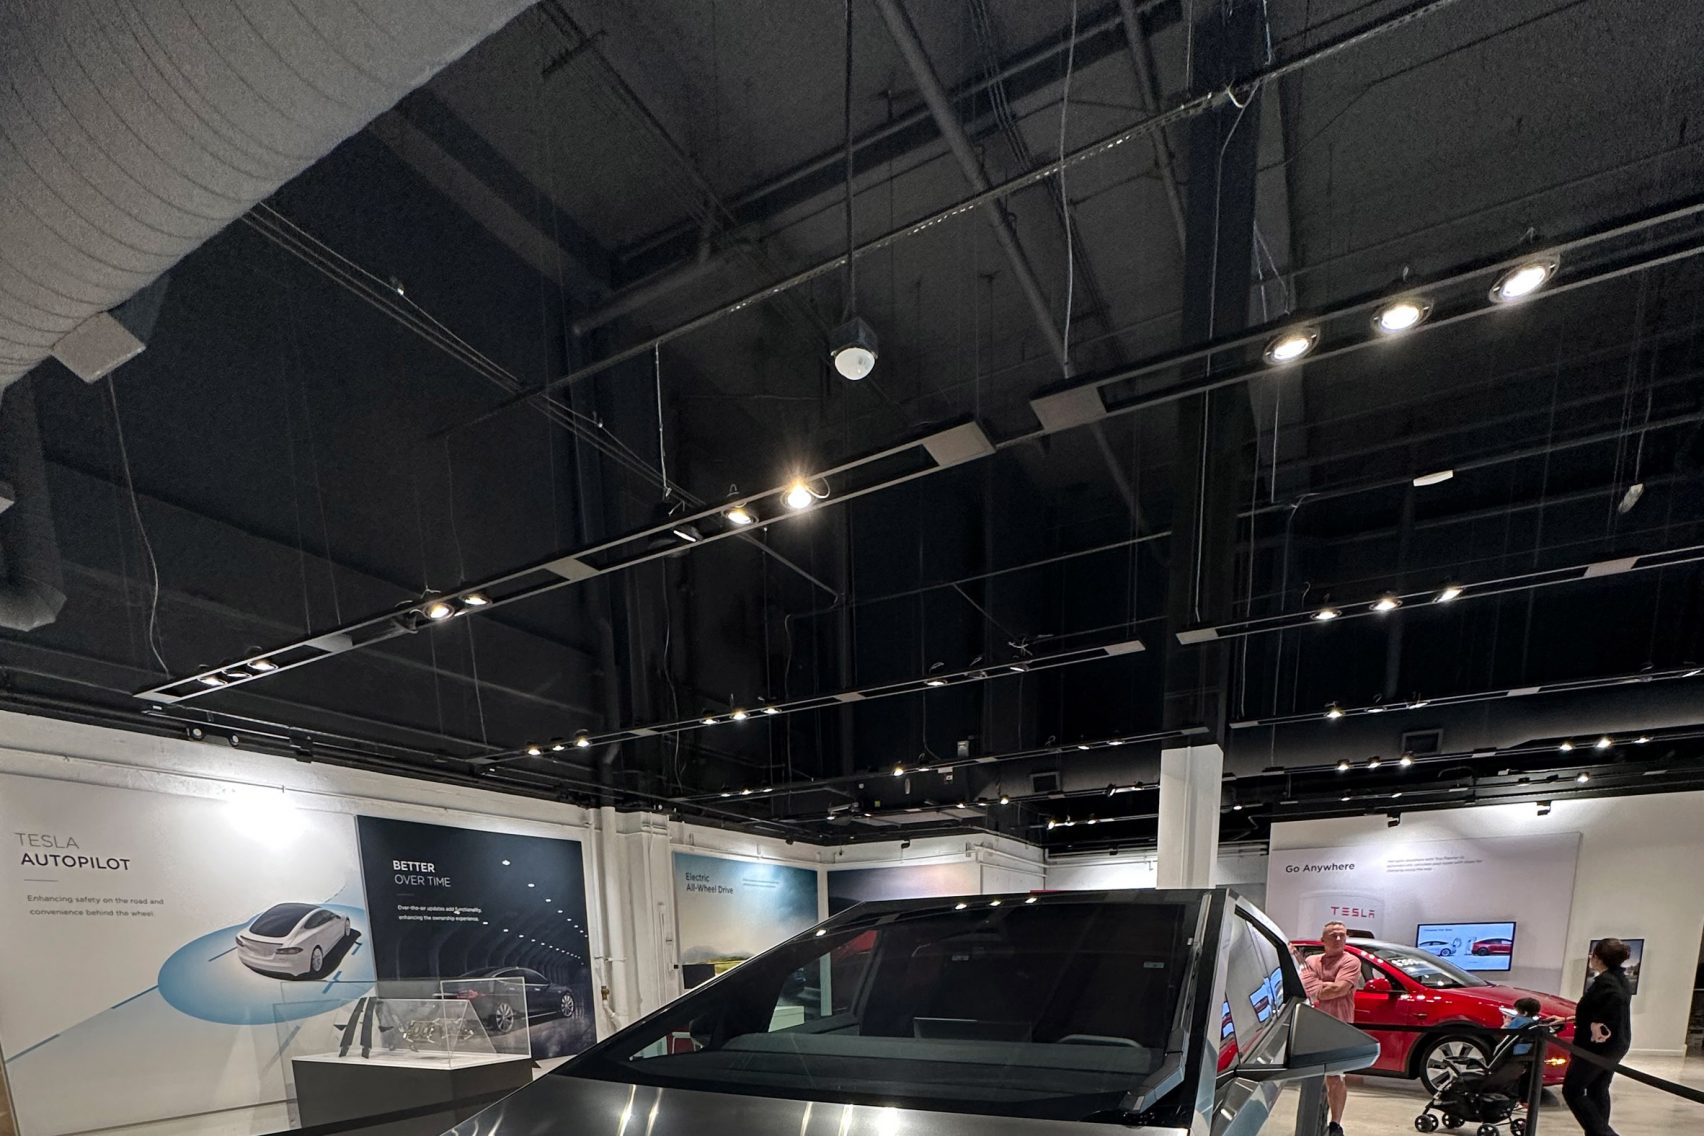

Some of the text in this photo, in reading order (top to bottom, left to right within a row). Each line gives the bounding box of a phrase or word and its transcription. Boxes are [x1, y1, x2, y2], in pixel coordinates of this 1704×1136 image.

[15, 832, 80, 849] TESLA
[21, 852, 130, 870] AUTOPILOT
[392, 860, 435, 873] BETTER
[1285, 862, 1355, 873] Go Anywhere
[394, 873, 451, 887] OVER TIME
[685, 872, 710, 882] Electric
[686, 883, 716, 893] All-Wheel
[718, 885, 734, 894] Drive
[27, 895, 73, 903] Enhancing
[75, 896, 101, 904] safety
[115, 896, 128, 904] the
[149, 897, 164, 905] and
[1331, 905, 1376, 918] TESLA
